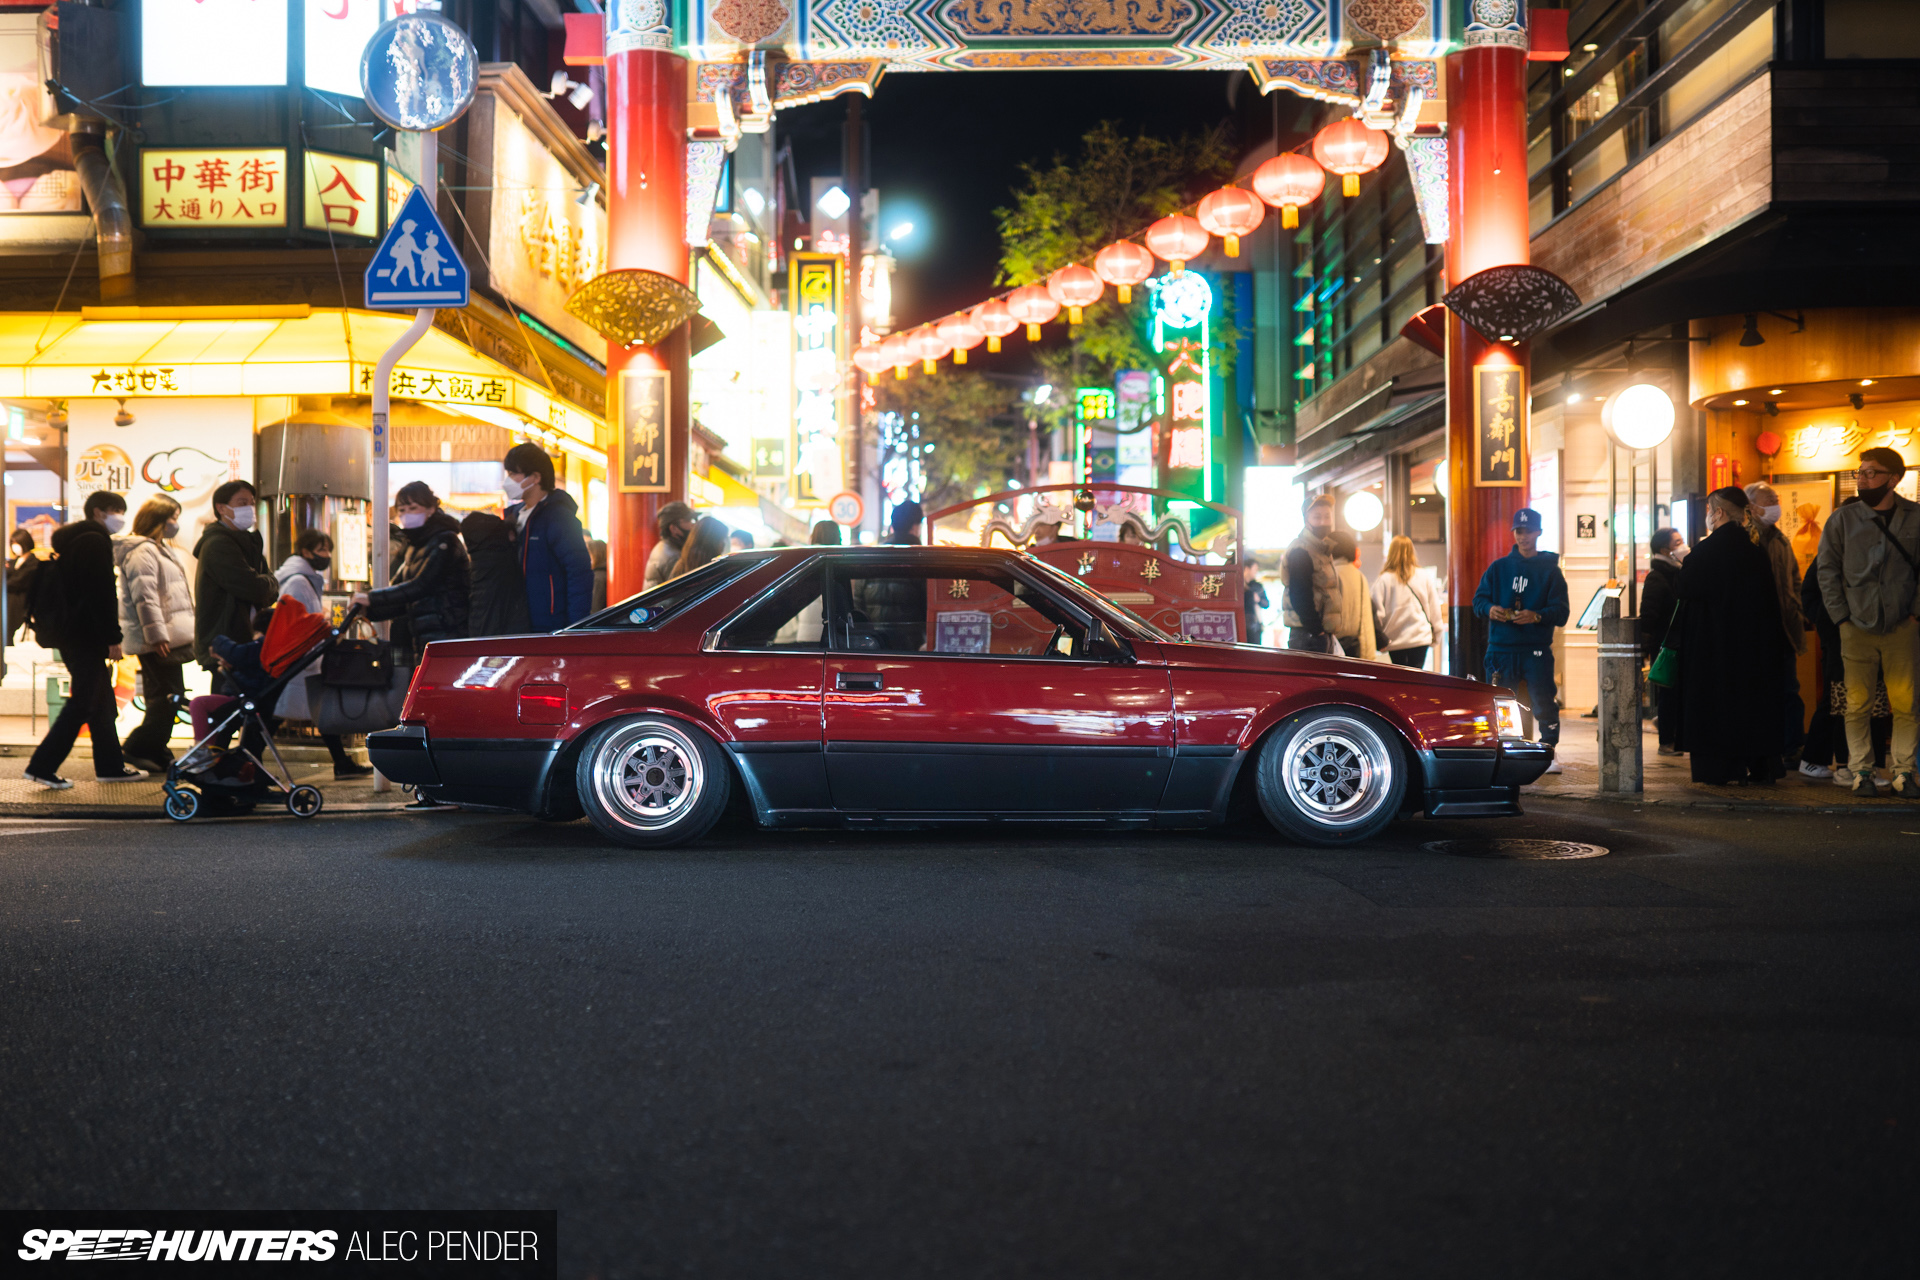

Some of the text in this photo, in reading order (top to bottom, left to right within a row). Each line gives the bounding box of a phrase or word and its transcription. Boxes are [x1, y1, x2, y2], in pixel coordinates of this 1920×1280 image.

[152, 158, 279, 194] 中華街
[317, 164, 366, 227] 入口
[152, 197, 278, 220] 大通り入口
[91, 368, 179, 393] 大粒甘栗
[77, 451, 132, 491] 元祖
[77, 481, 103, 490] Since
[837, 502, 857, 518] 30
[1512, 576, 1528, 593] GAP
[1185, 614, 1230, 623] 新型コロナ
